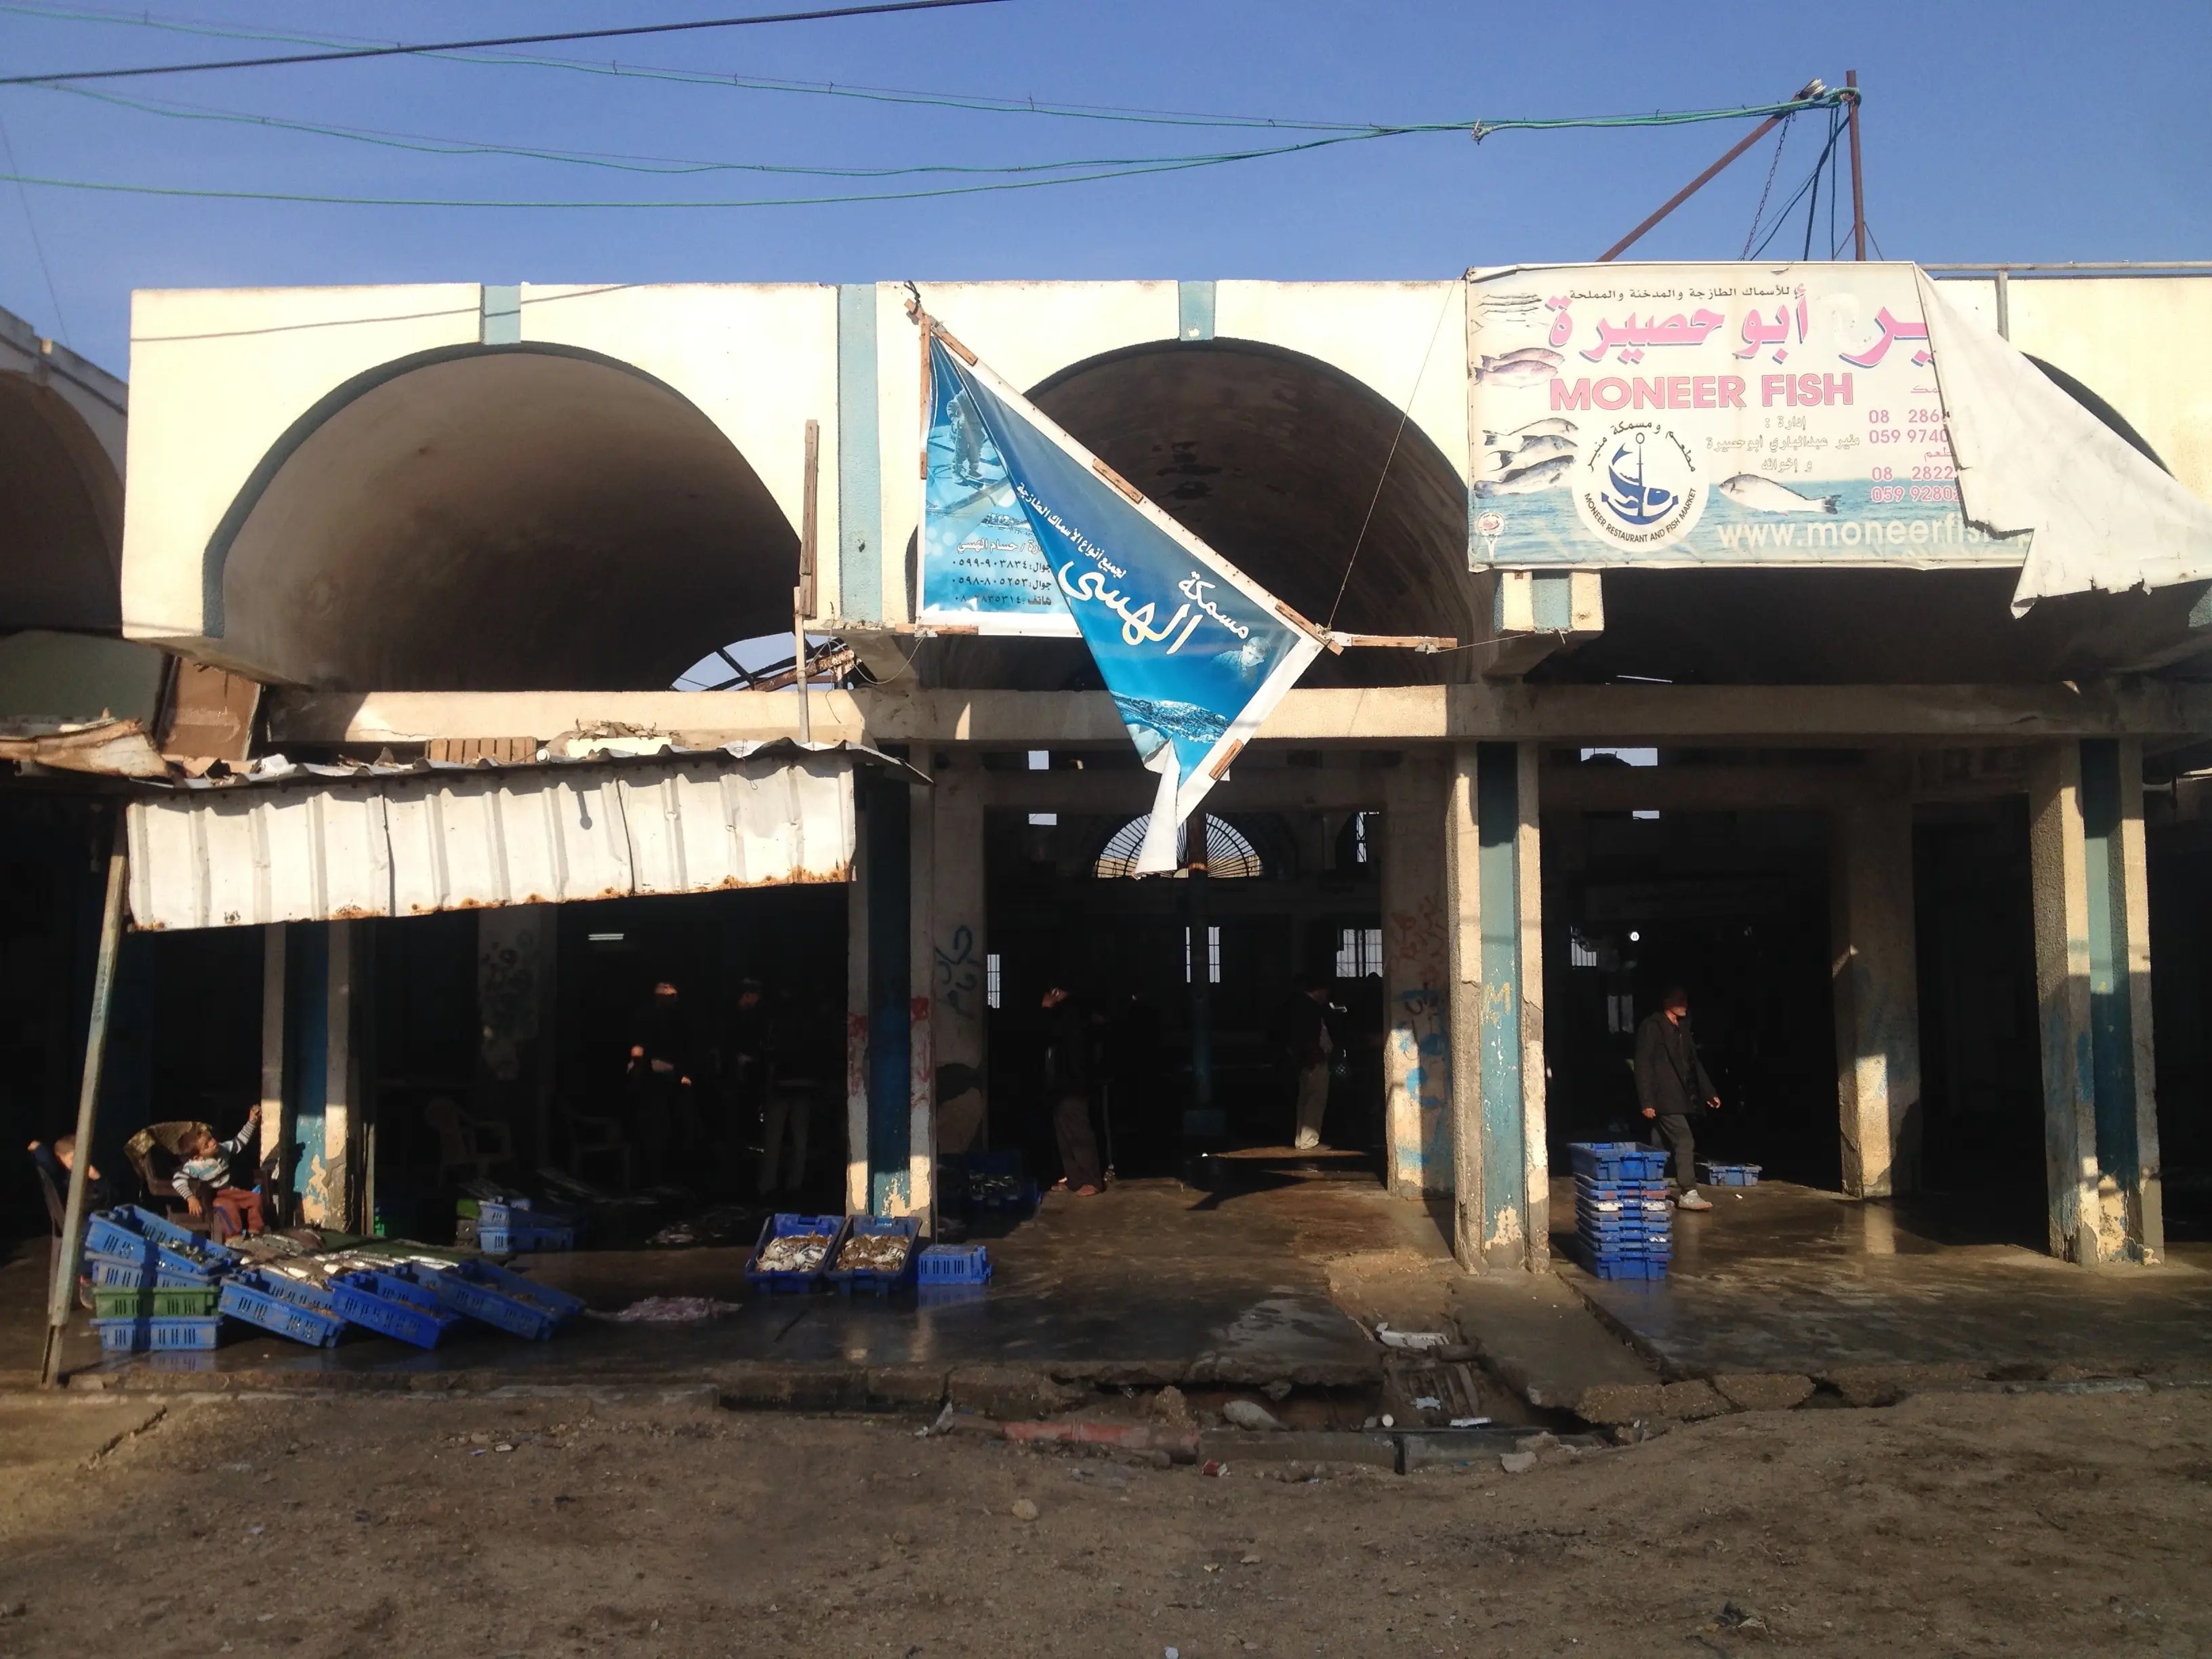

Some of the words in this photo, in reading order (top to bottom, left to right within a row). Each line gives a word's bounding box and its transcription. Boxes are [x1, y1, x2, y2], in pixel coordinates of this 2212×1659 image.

[1689, 287, 1737, 300] الطازجة
[1742, 284, 1790, 296] للأسماك
[1550, 376, 1747, 411] MONEER
[1761, 373, 1853, 408] FISH
[1868, 409, 1889, 424] 08
[1835, 434, 1860, 449] منير
[1868, 428, 1901, 445] 059
[1871, 467, 1893, 482] 08
[1017, 482, 1051, 518] الطازجة
[1871, 487, 1904, 503] 059
[1584, 493, 1608, 527] MONEER
[1606, 523, 1648, 543] RESTAURANT
[1650, 529, 1665, 542] AND
[1666, 517, 1681, 533] FISH
[1680, 487, 1697, 520] MARKET
[1047, 514, 1084, 545] الأسماك
[1078, 539, 1105, 560] أنواع
[1097, 557, 1127, 579] لجميع
[1178, 571, 1249, 639] مسمكة
